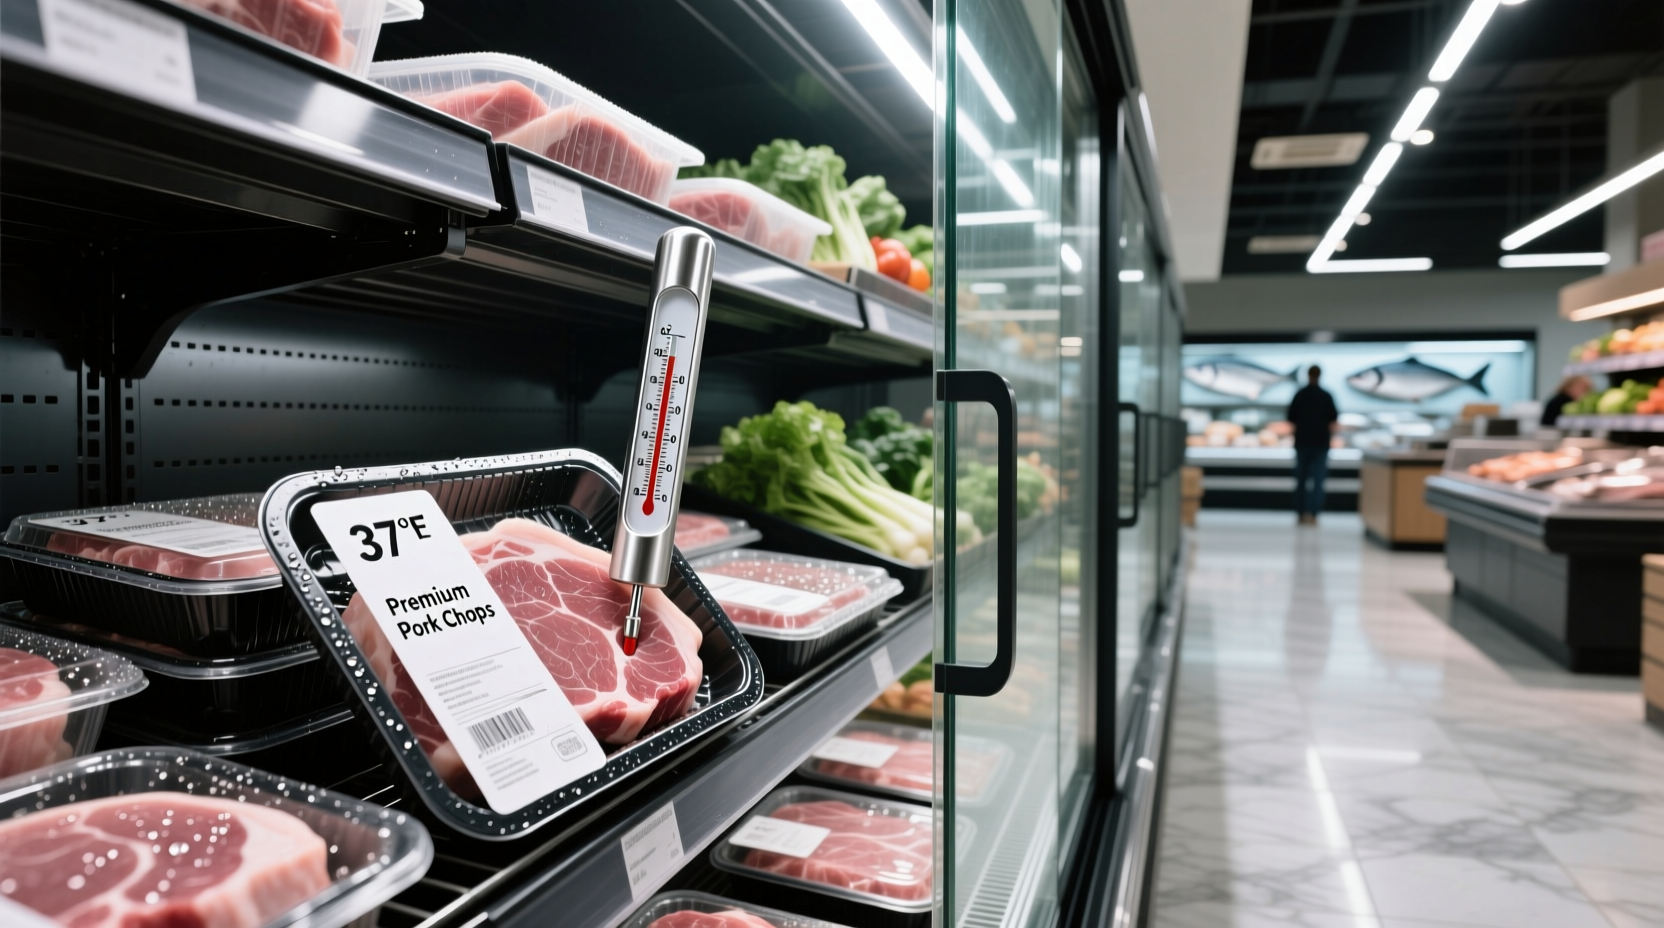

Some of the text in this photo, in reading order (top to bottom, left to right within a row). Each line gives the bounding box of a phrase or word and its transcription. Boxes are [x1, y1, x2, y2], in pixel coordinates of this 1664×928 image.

[349, 514, 431, 562] 37°E
[385, 585, 470, 616] Premium
[397, 604, 496, 640] Pork Chops
